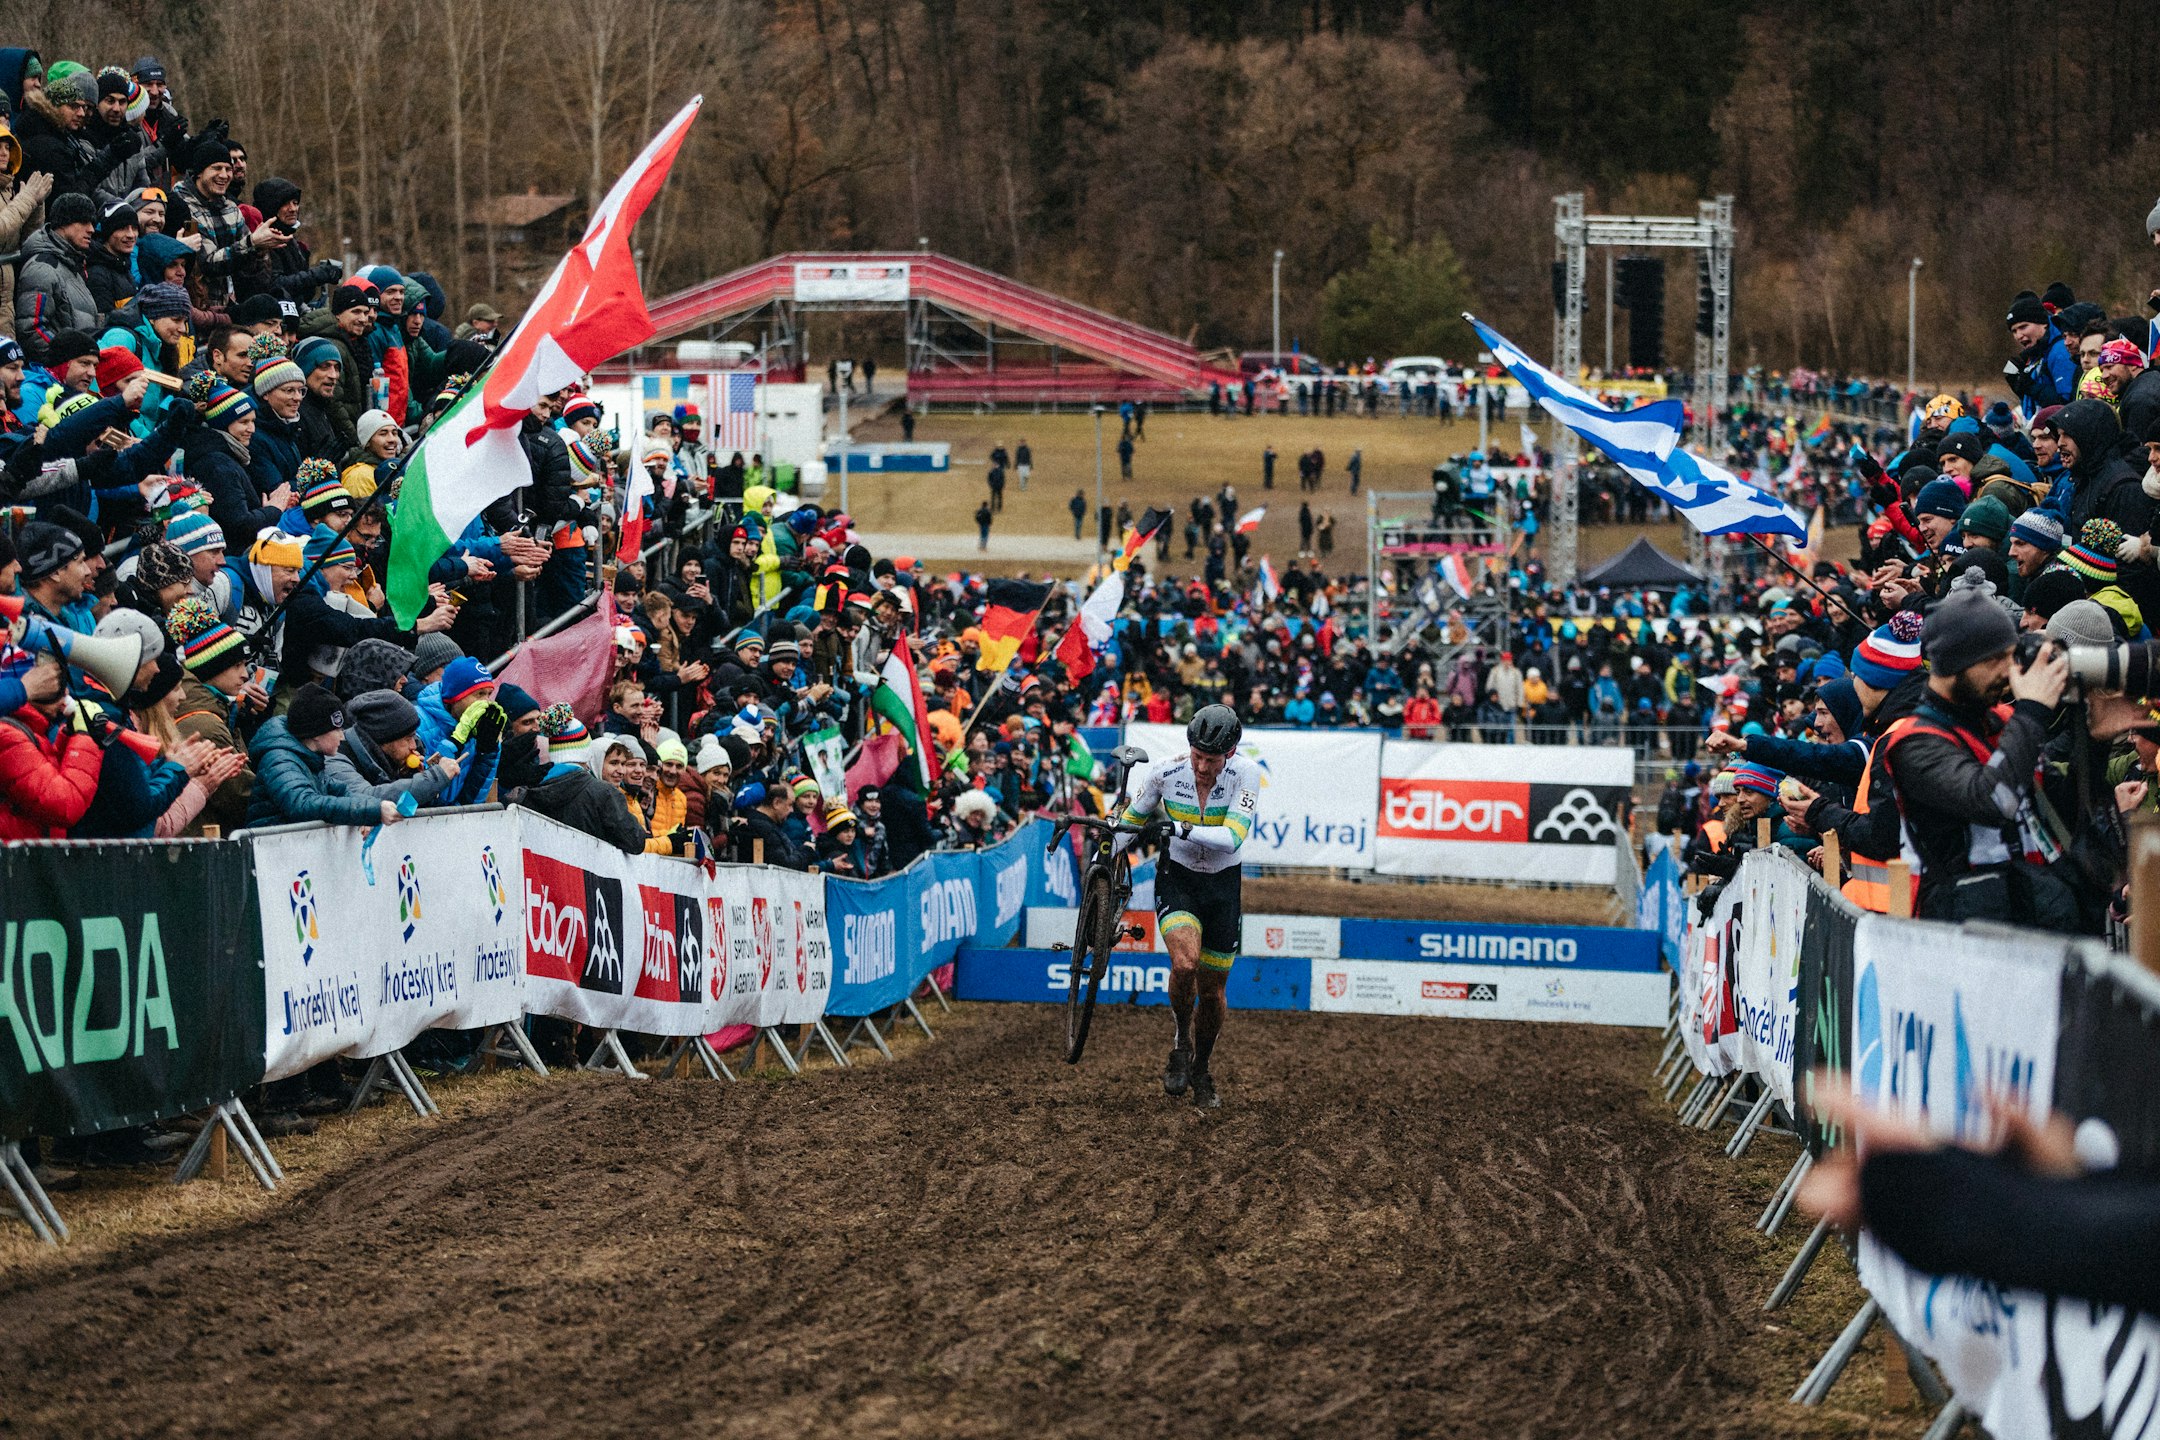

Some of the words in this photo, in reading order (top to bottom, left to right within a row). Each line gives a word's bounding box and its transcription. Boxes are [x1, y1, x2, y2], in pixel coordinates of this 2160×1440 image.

[1241, 797, 1255, 811] 52
[1304, 815, 1366, 853] kraj
[1419, 933, 1578, 963] SHIMANO
[0, 912, 180, 1075] KODA
[436, 949, 458, 1001] kraj
[1047, 963, 1171, 993] SIMA
[336, 971, 364, 1026] kraj
